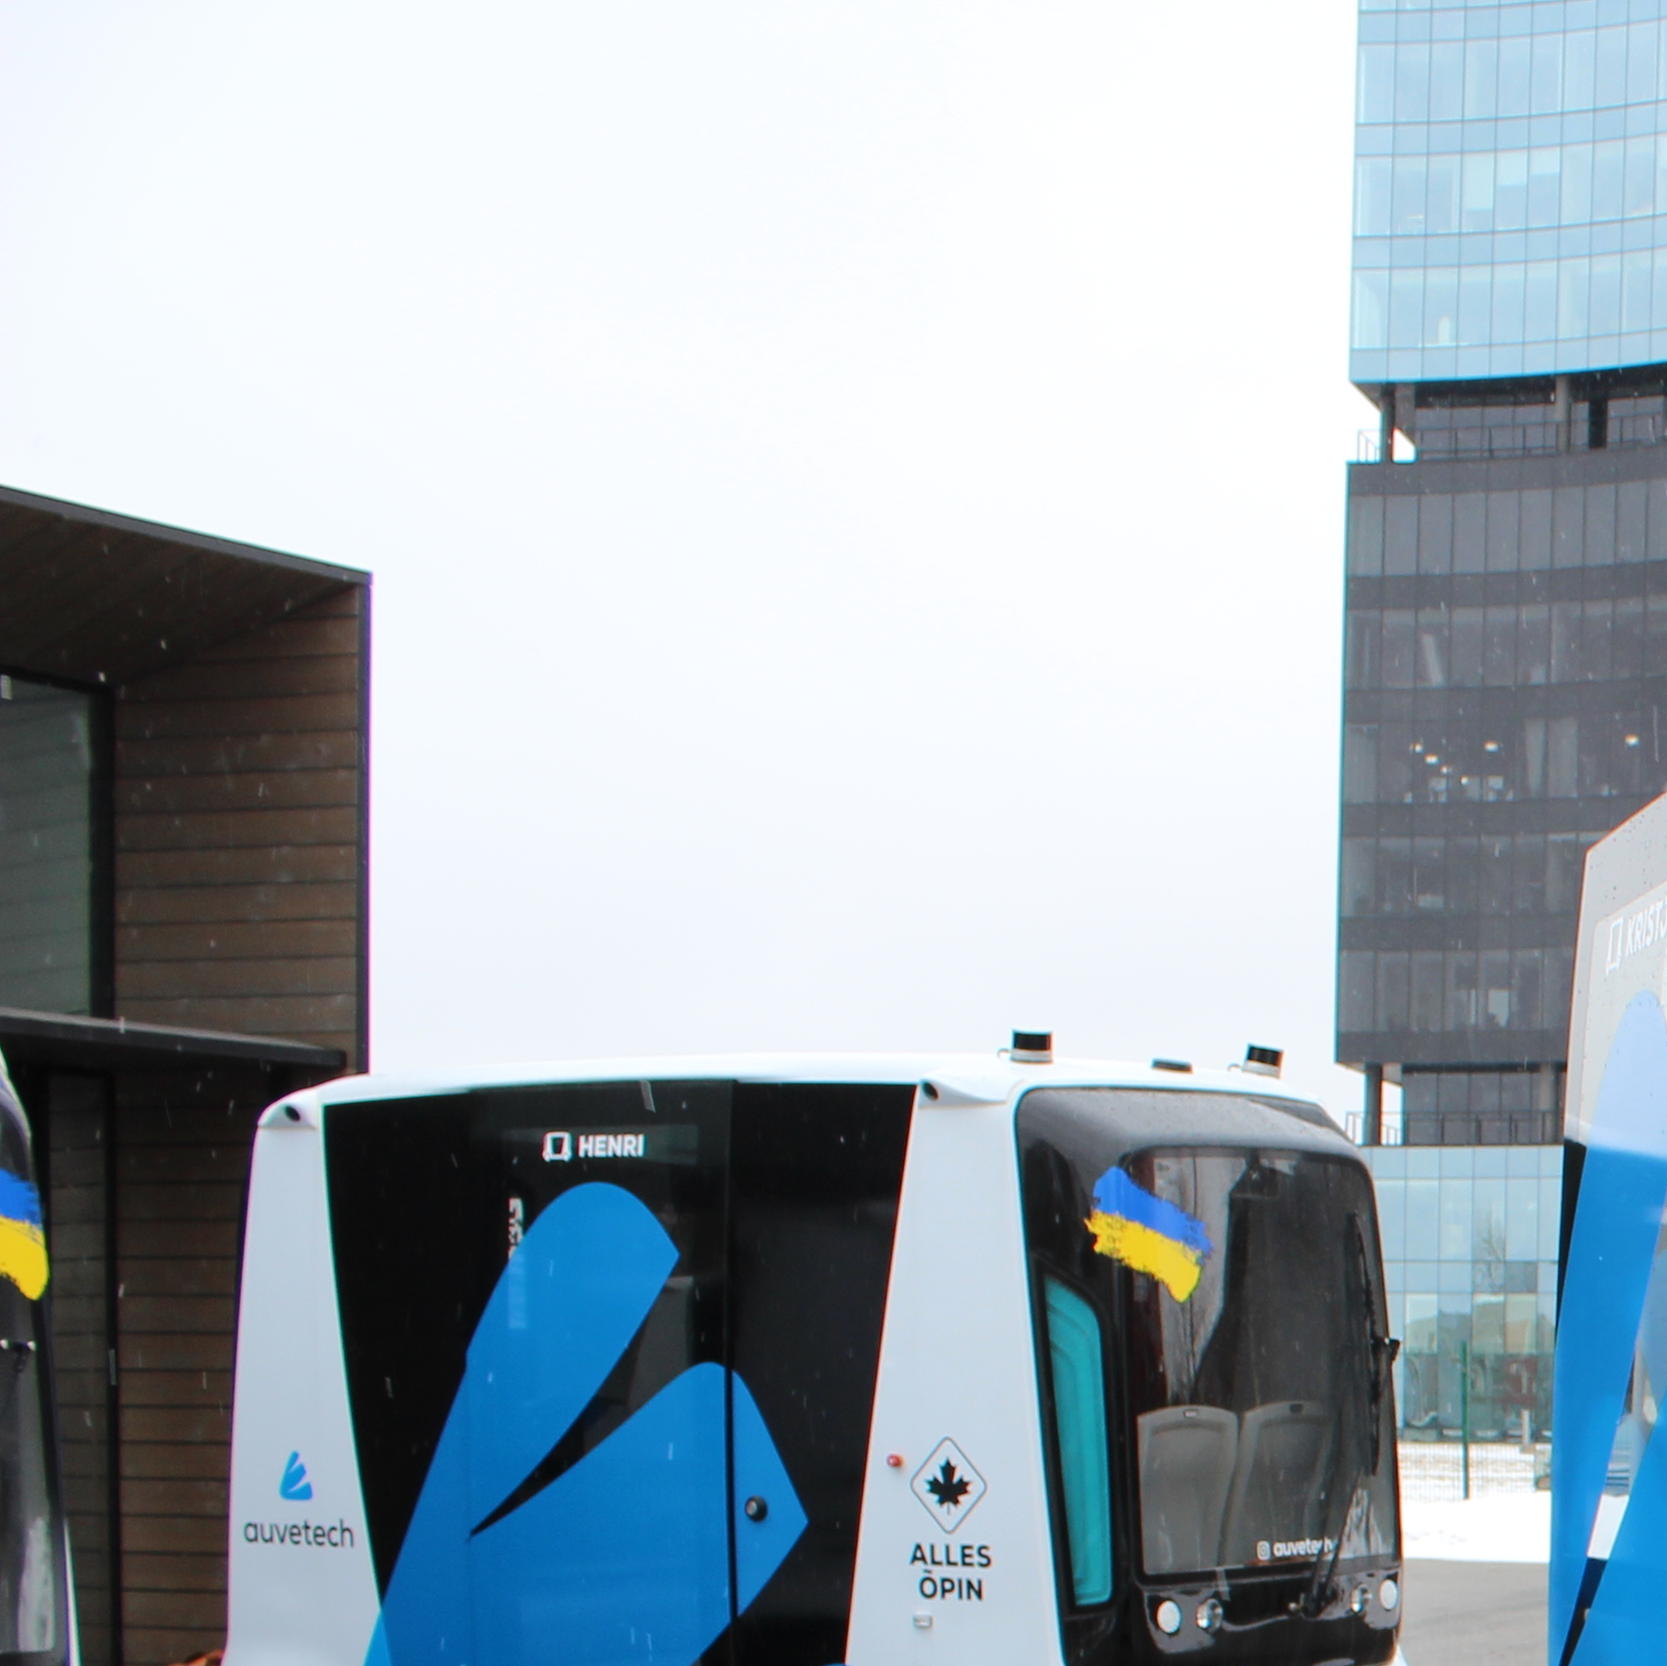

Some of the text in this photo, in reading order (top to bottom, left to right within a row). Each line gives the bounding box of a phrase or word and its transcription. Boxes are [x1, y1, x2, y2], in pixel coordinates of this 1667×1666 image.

[578, 1133, 645, 1158] HENRI
[243, 1518, 355, 1549] auvetech
[909, 1542, 992, 1568] ALLES
[919, 1568, 983, 1602] ÕPIN
